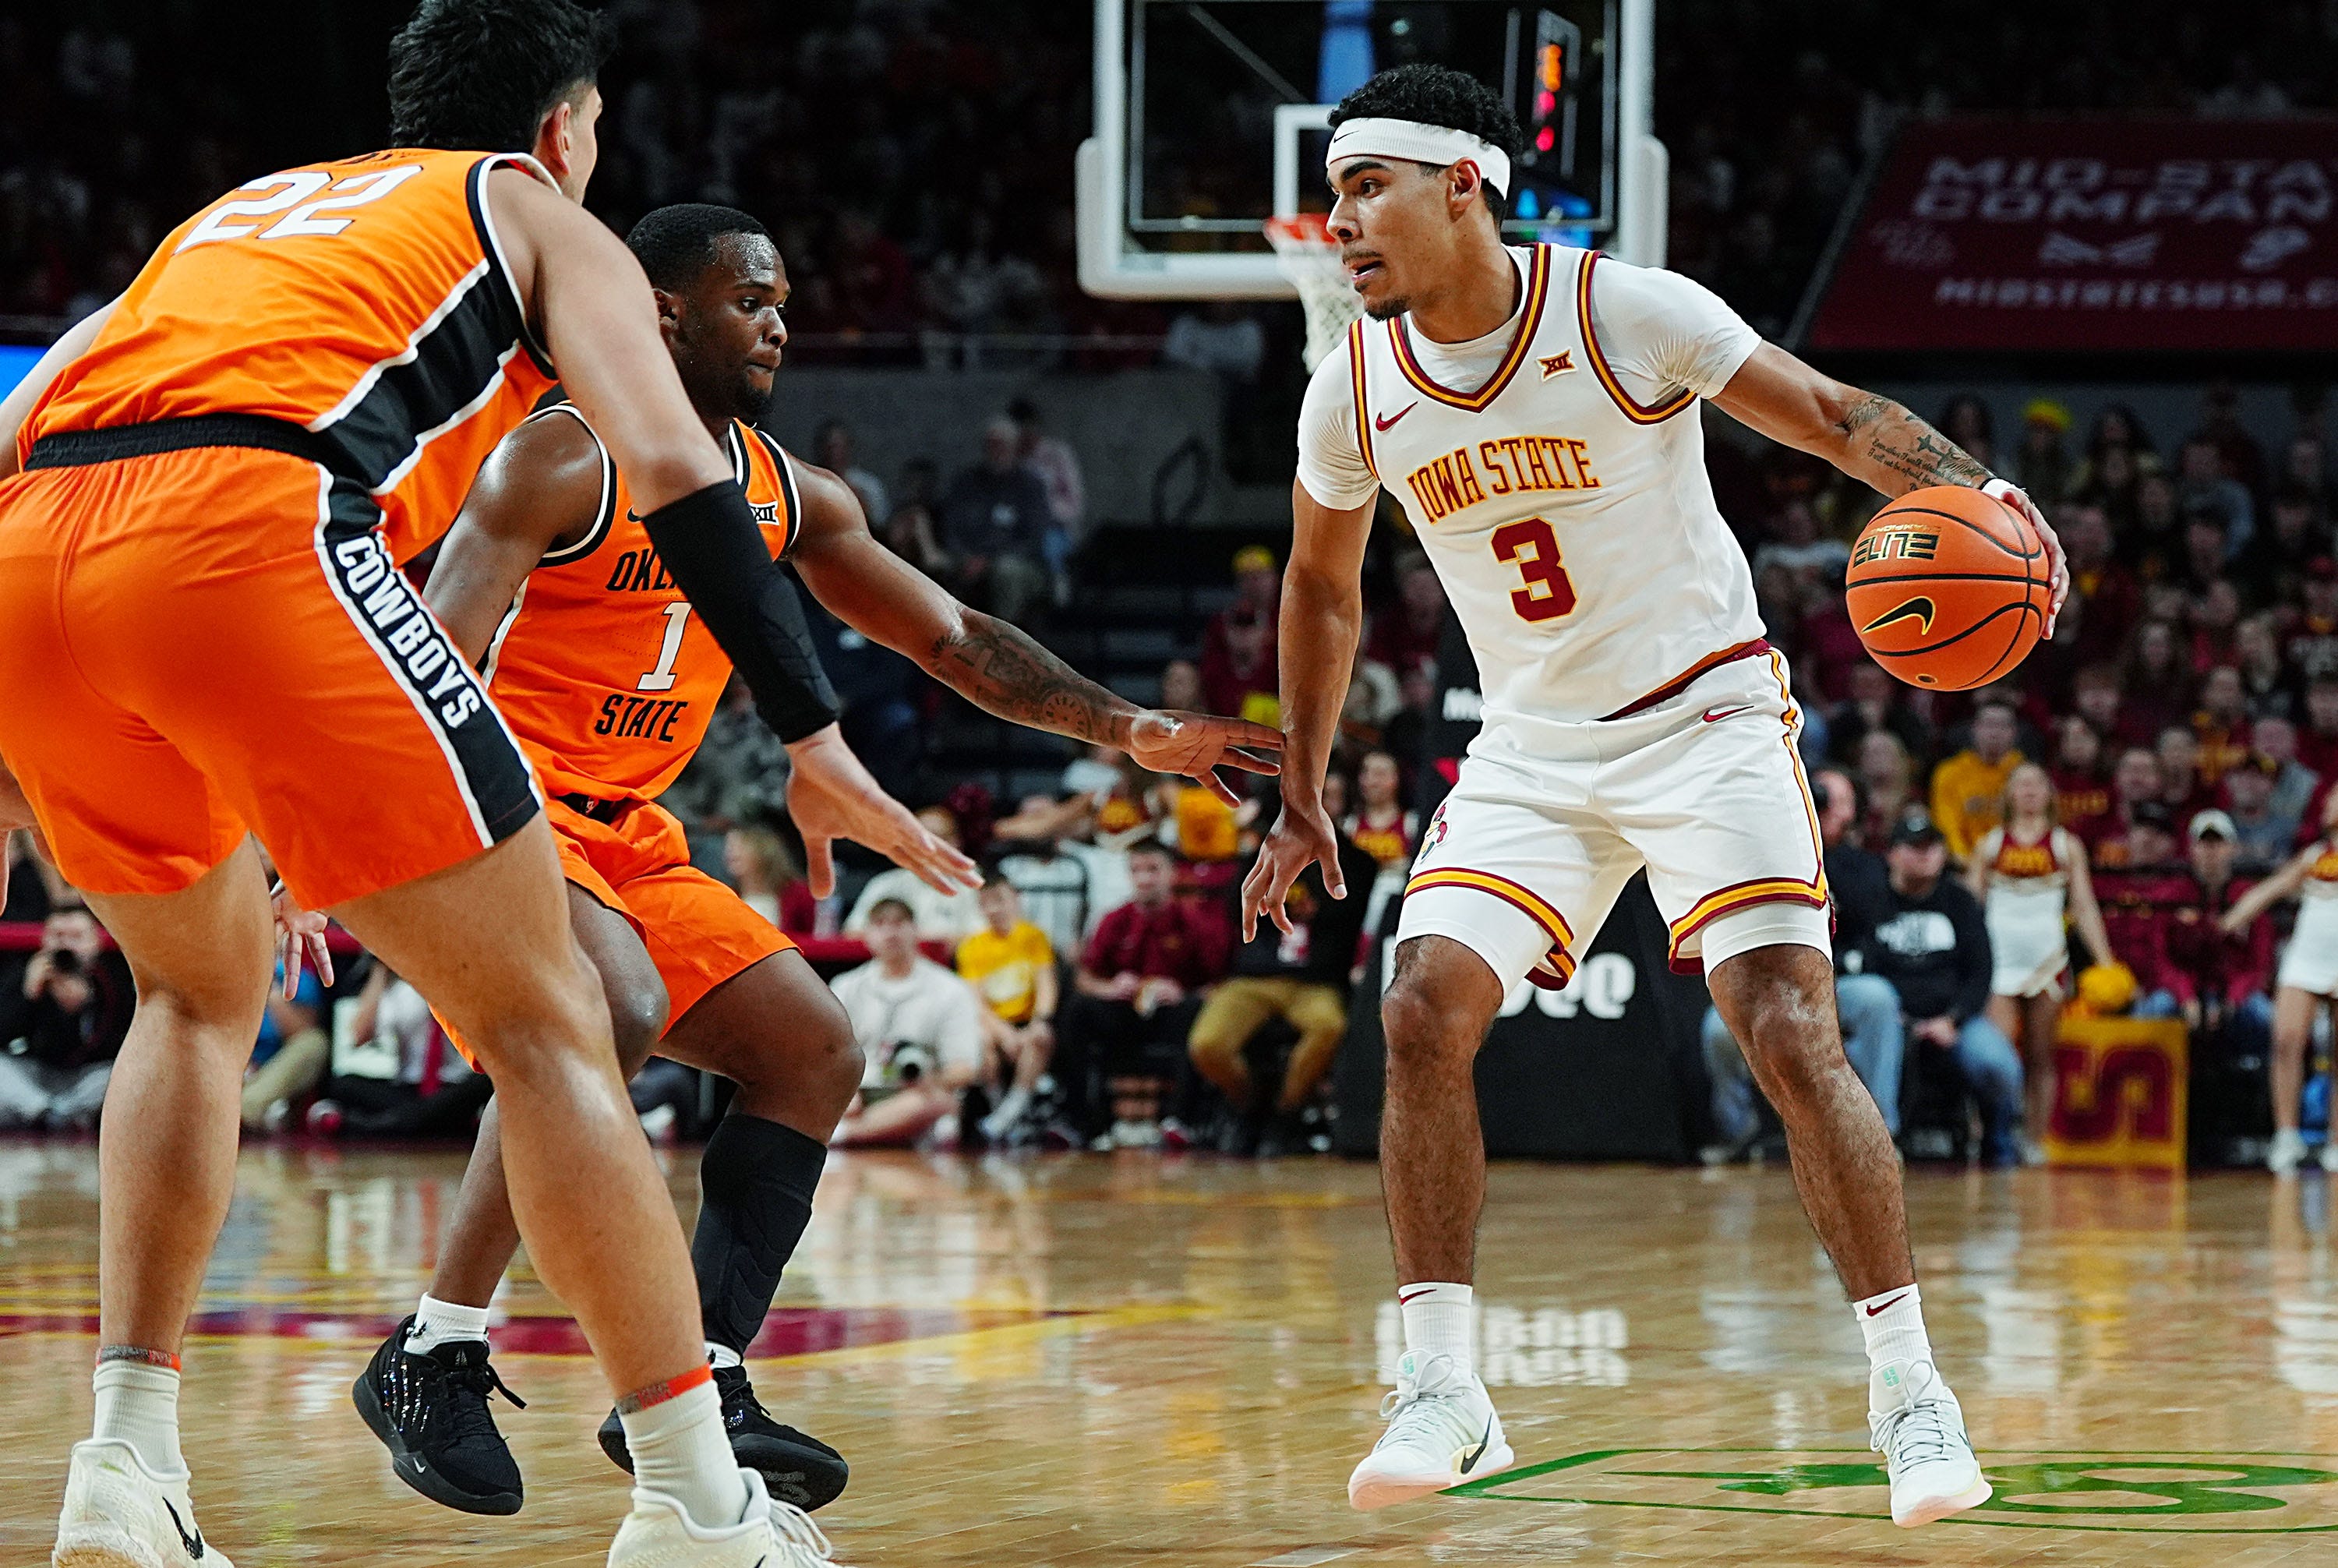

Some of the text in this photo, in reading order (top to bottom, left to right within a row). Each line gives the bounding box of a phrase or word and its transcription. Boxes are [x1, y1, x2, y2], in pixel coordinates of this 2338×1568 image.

[173, 164, 423, 256] 22
[1926, 158, 2338, 189] MID-STA
[1405, 436, 1602, 525] IOWA STATE
[605, 546, 677, 592] OKL
[1489, 517, 1578, 623] 3
[1852, 531, 1940, 568] ELITE
[335, 535, 481, 729] COWBOYS
[636, 600, 693, 691] 1
[594, 694, 689, 743] STATE
